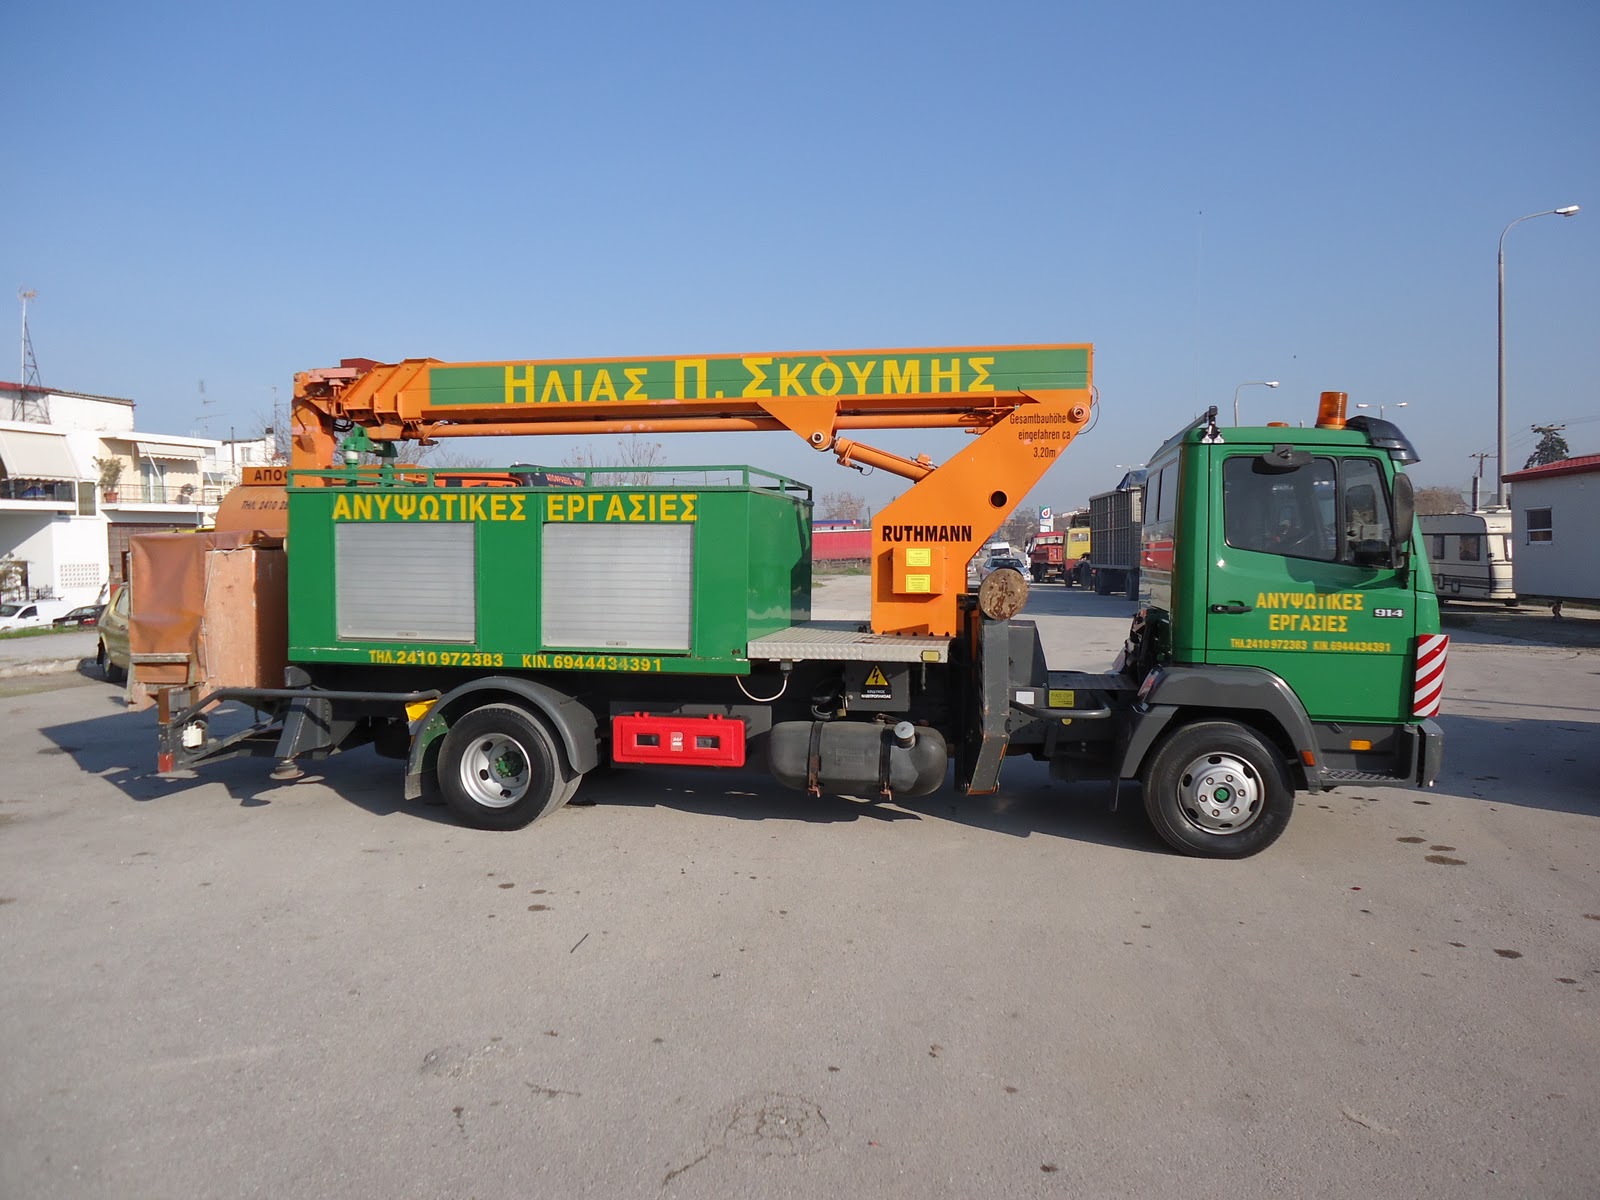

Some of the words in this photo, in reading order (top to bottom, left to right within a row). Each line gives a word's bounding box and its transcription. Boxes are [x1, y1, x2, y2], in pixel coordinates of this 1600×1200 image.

[505, 365, 648, 404] ΗΛΙΑΣ
[675, 358, 724, 399] Π.
[742, 356, 995, 398] ΣΚΟΥΜΗΣ
[1009, 412, 1067, 424] Gesamtbauhöhe
[1018, 429, 1060, 442] eingefahren
[1062, 431, 1071, 440] ca
[332, 493, 527, 522] ΑΝΥΨΩΤΙΚΕΣ
[547, 494, 698, 522] ΕΡΓΑΣΙΕΣ
[882, 525, 972, 542] RUTHMANN
[1256, 592, 1364, 611] ΑΝΥΨΩΤΙΚΕΣ
[1374, 608, 1404, 618] 914
[1269, 614, 1348, 632] ΕΡΓΑΣΙΕΣ
